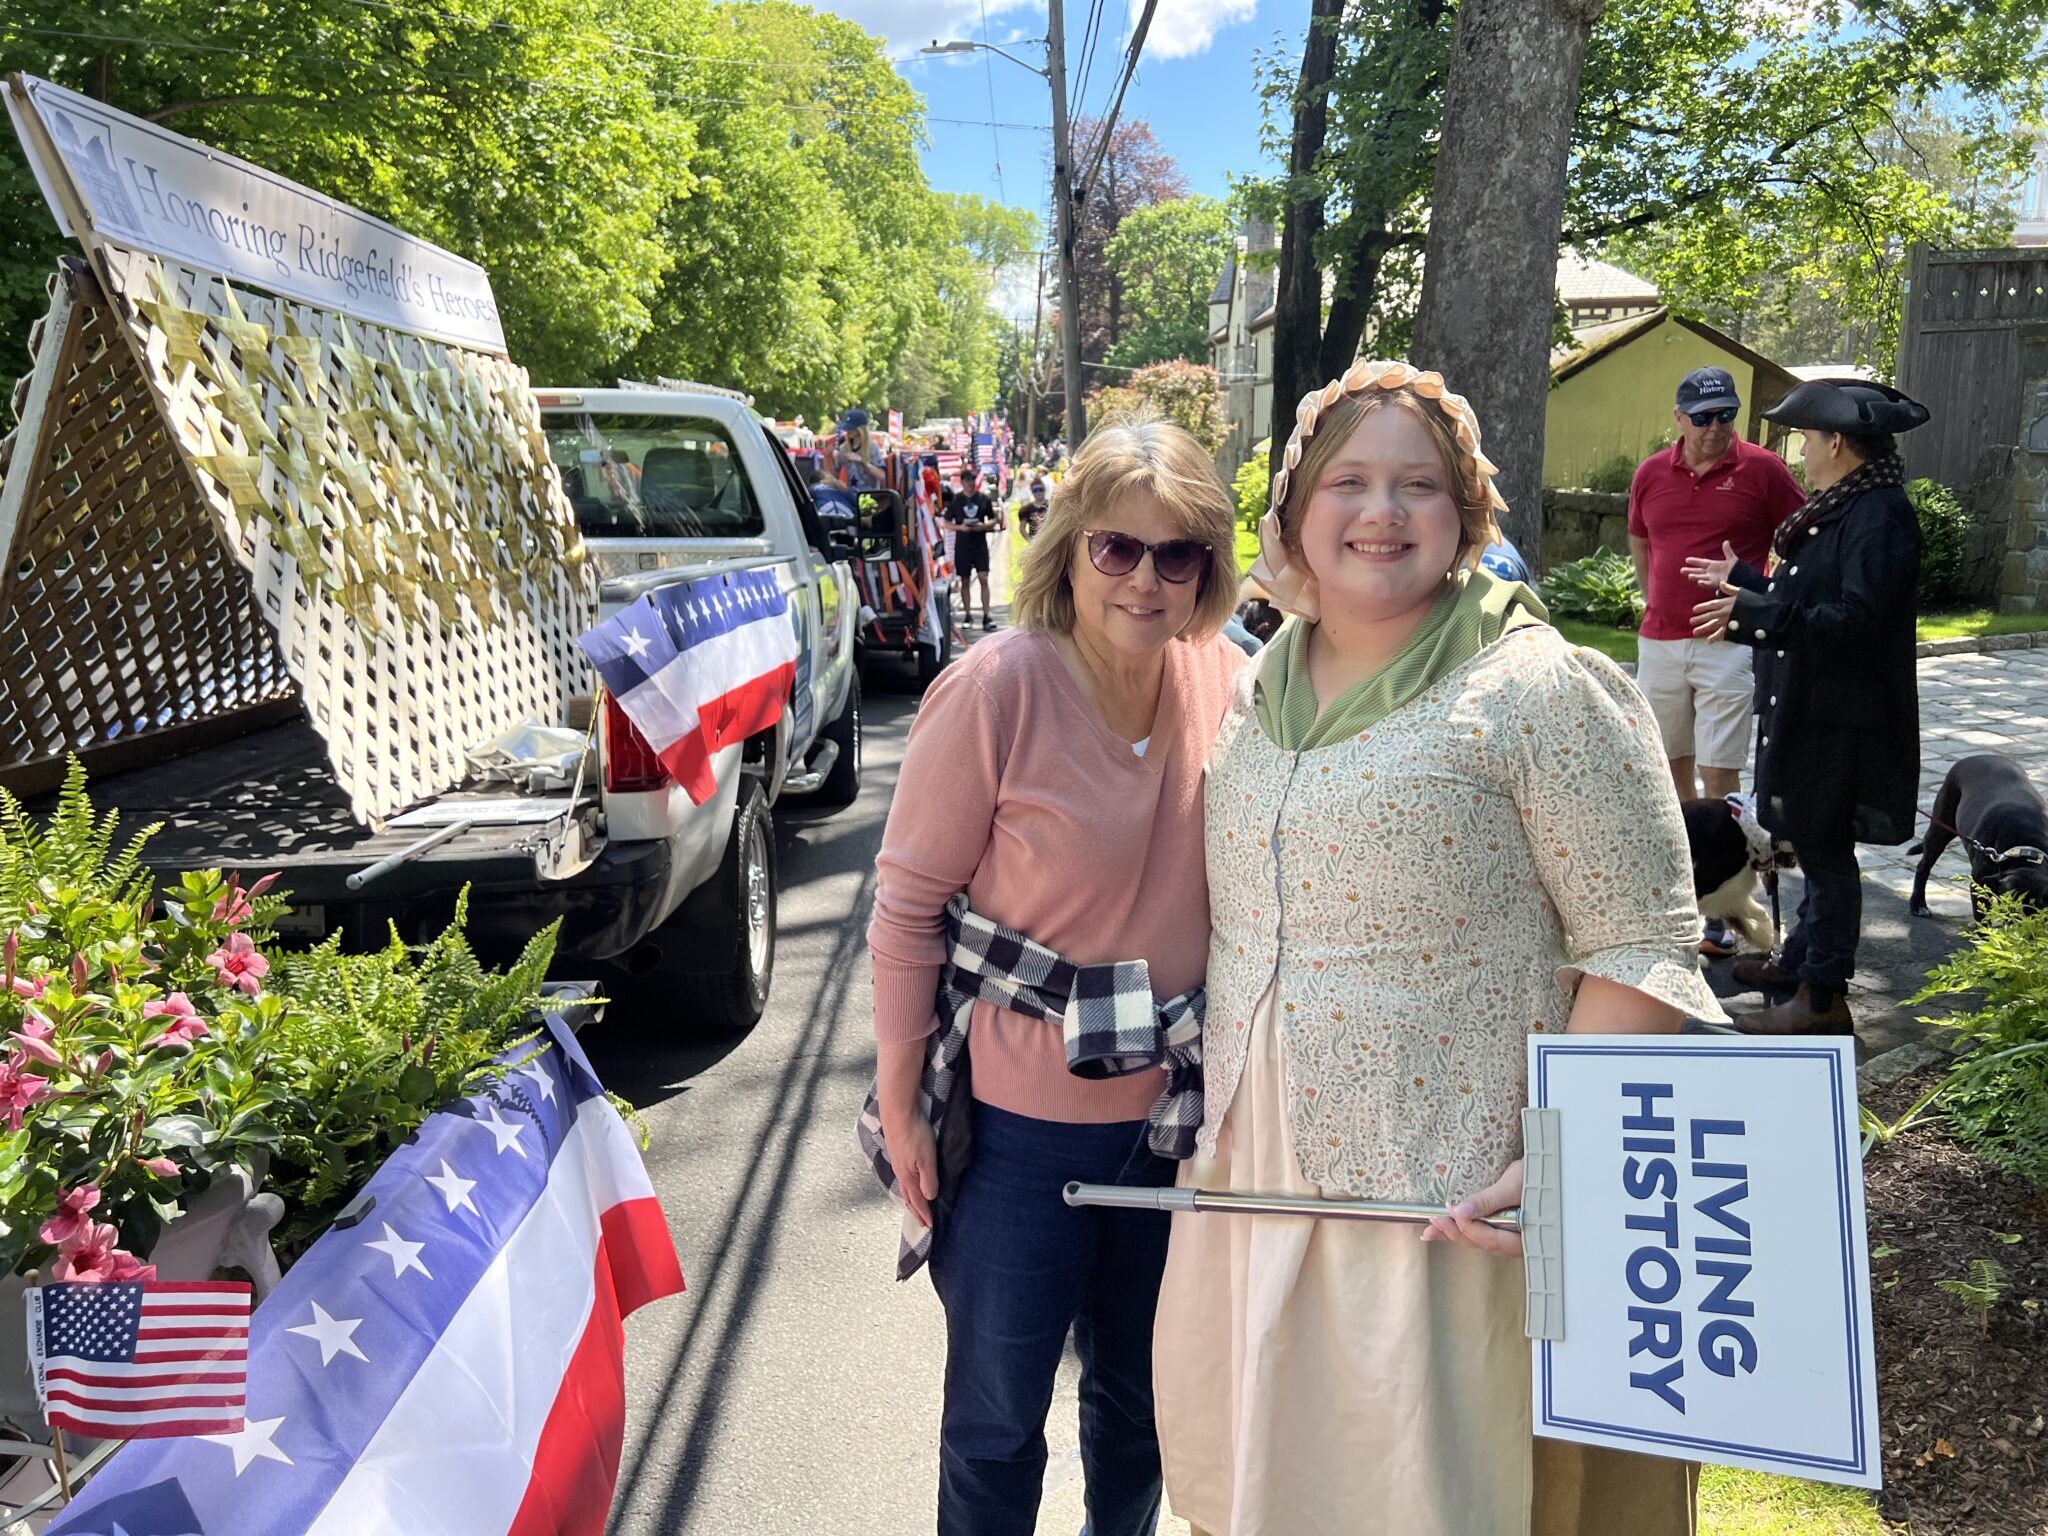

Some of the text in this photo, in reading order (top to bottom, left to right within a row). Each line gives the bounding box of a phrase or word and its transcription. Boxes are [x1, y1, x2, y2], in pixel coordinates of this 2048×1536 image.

[124, 157, 498, 323] Honoring Ridgefield's Heroes
[1621, 1082, 1686, 1415] HISTORY
[1690, 1118, 1758, 1378] LIVING
[34, 1295, 42, 1313] CLUB
[35, 1319, 44, 1356] EXCHANGE
[37, 1362, 45, 1395] NATIONAL
